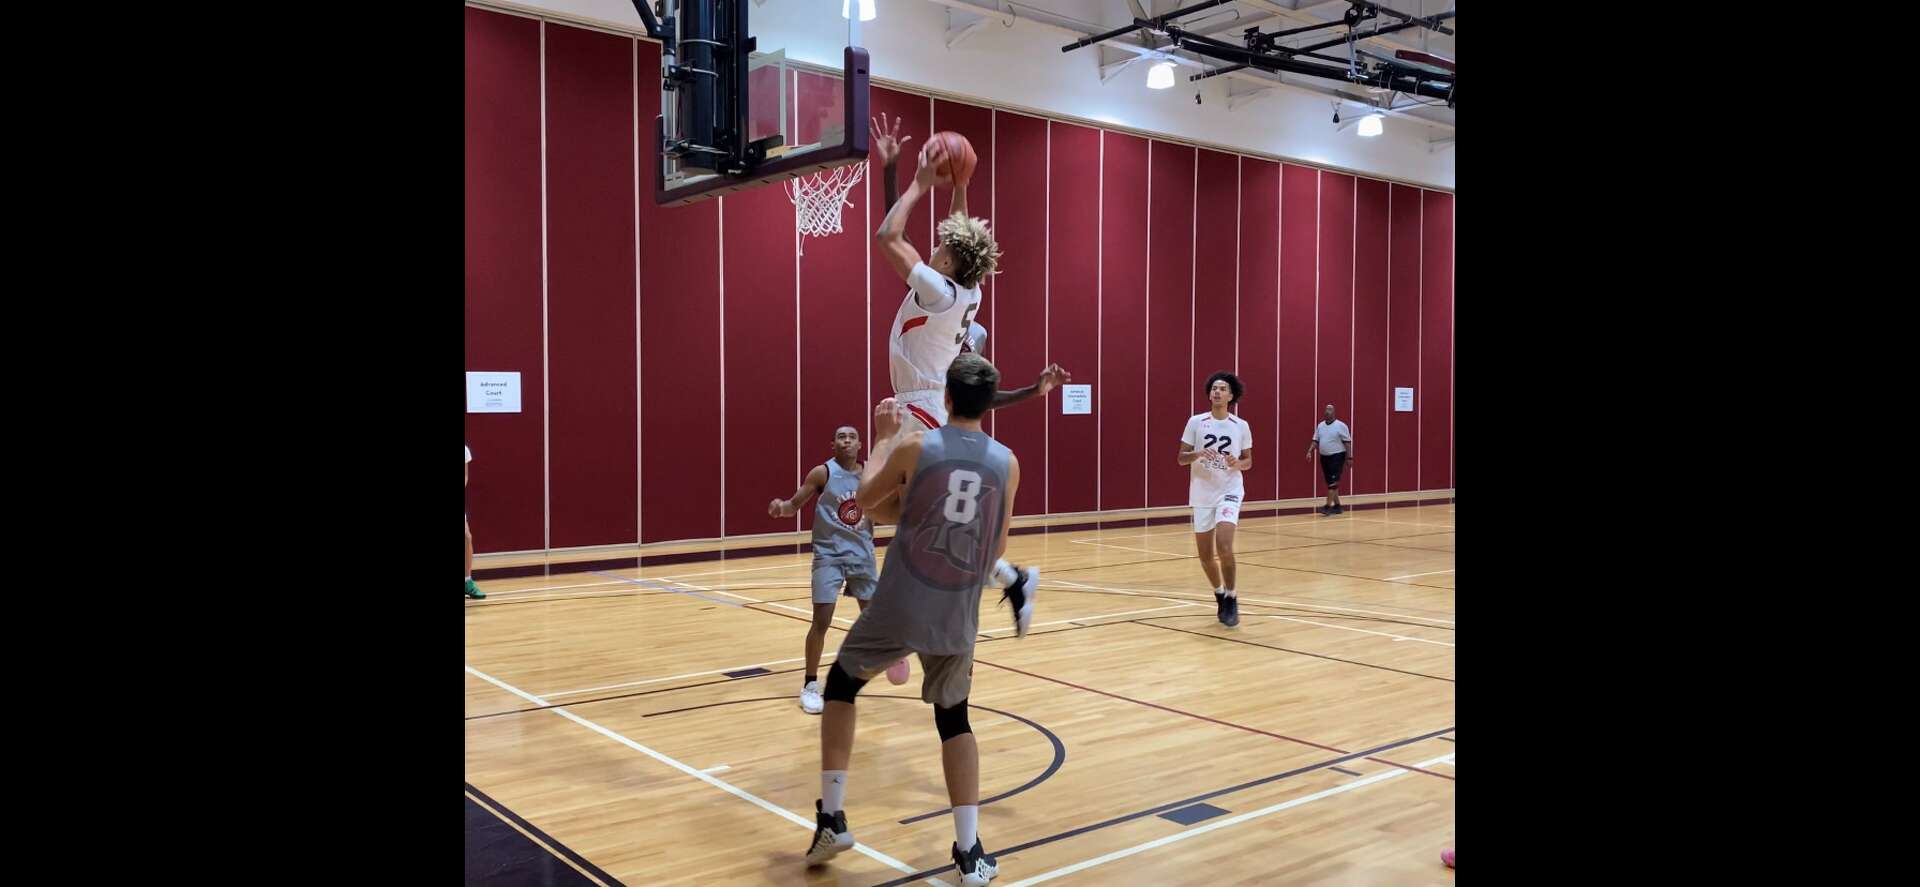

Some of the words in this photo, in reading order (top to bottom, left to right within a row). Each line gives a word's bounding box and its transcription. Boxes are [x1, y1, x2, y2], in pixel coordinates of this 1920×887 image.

[955, 303, 977, 344] 5
[1203, 433, 1233, 456] 22
[944, 469, 982, 524] 8
